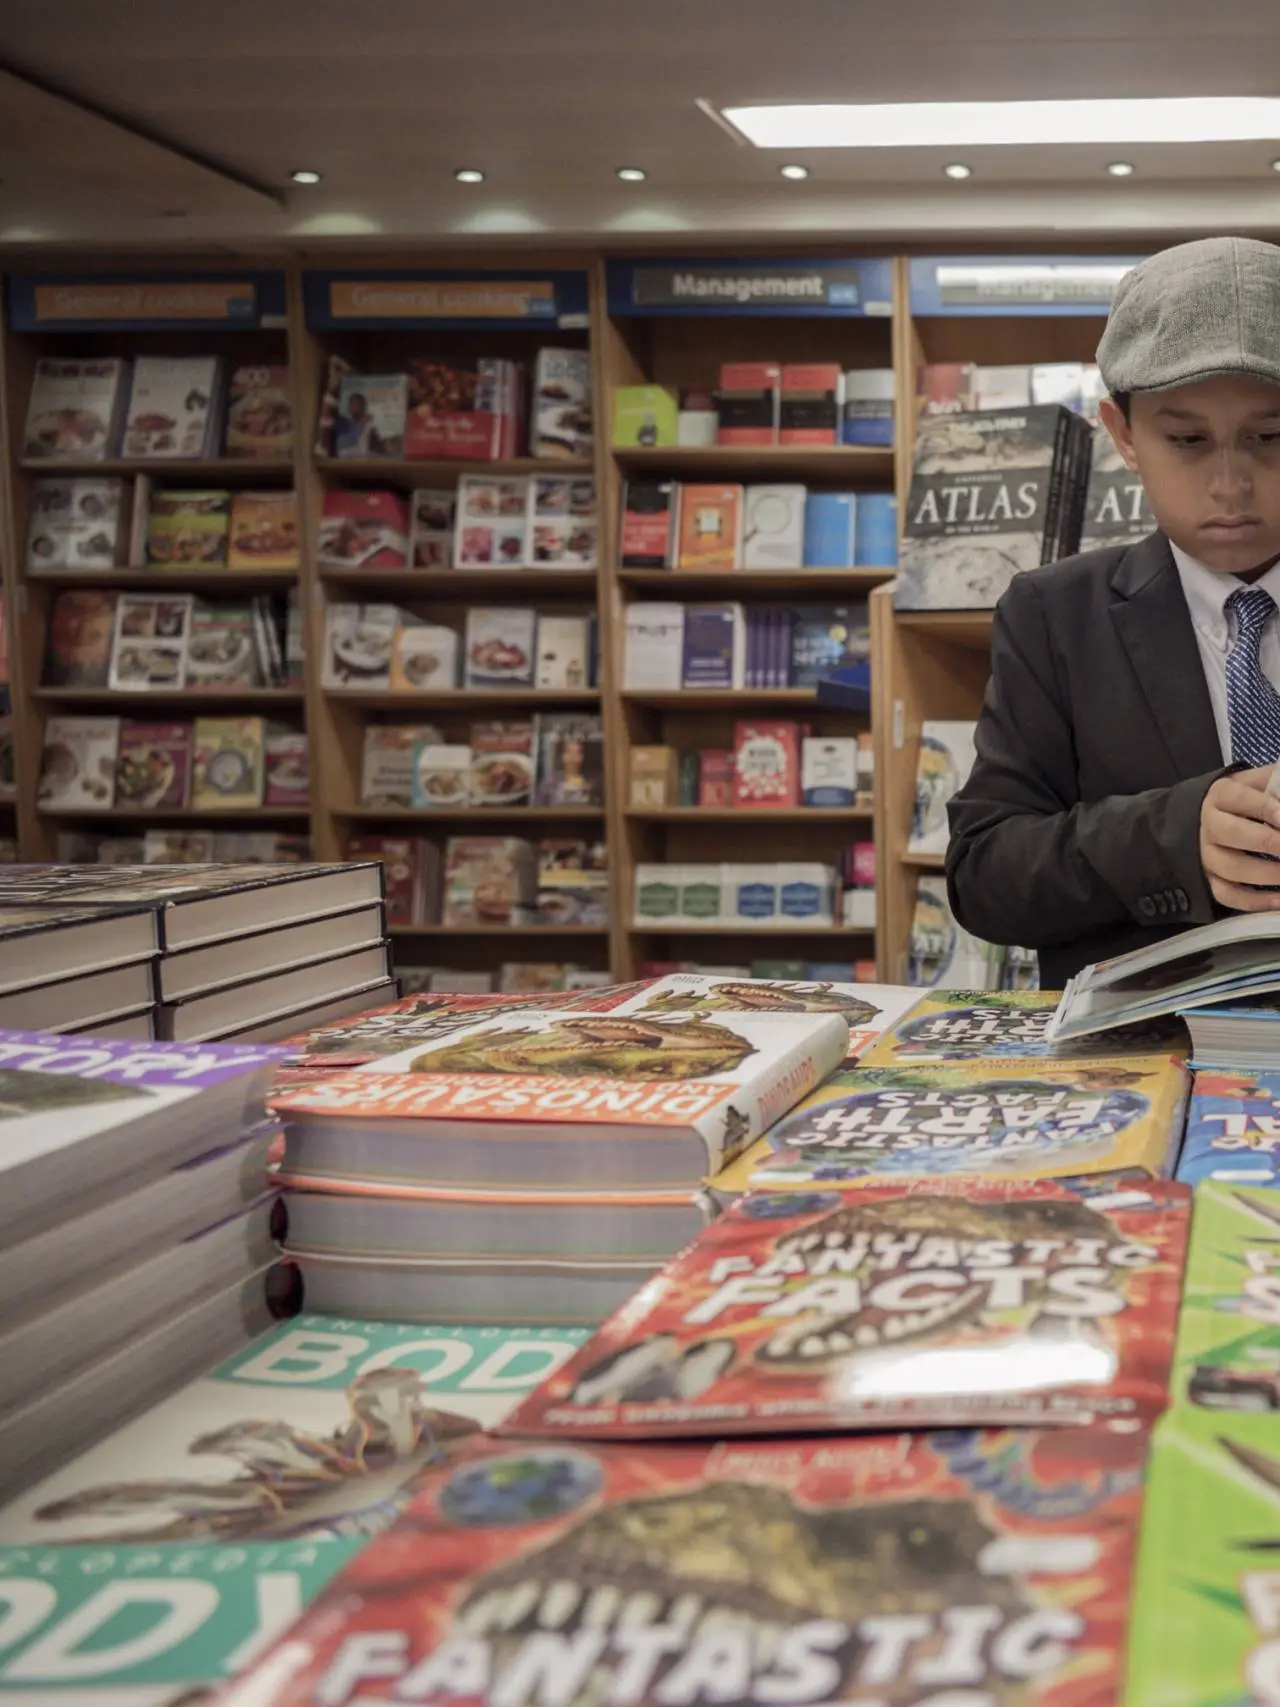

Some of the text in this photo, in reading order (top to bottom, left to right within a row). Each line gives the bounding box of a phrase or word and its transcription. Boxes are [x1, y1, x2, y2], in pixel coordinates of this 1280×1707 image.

[673, 274, 823, 301] Management
[913, 482, 1039, 524] ATLAS
[925, 1019, 1050, 1035] RTH
[973, 1009, 1058, 1021] CTS
[811, 1100, 1103, 1134] EARTH
[876, 1091, 1067, 1109] FACTS
[786, 1120, 1118, 1149] FANTASTIC
[708, 1236, 1158, 1284] FANTASTIC
[682, 1266, 1130, 1324] FACTS
[232, 1330, 580, 1394] BOD
[314, 1606, 1087, 1704] FANTASTIC
